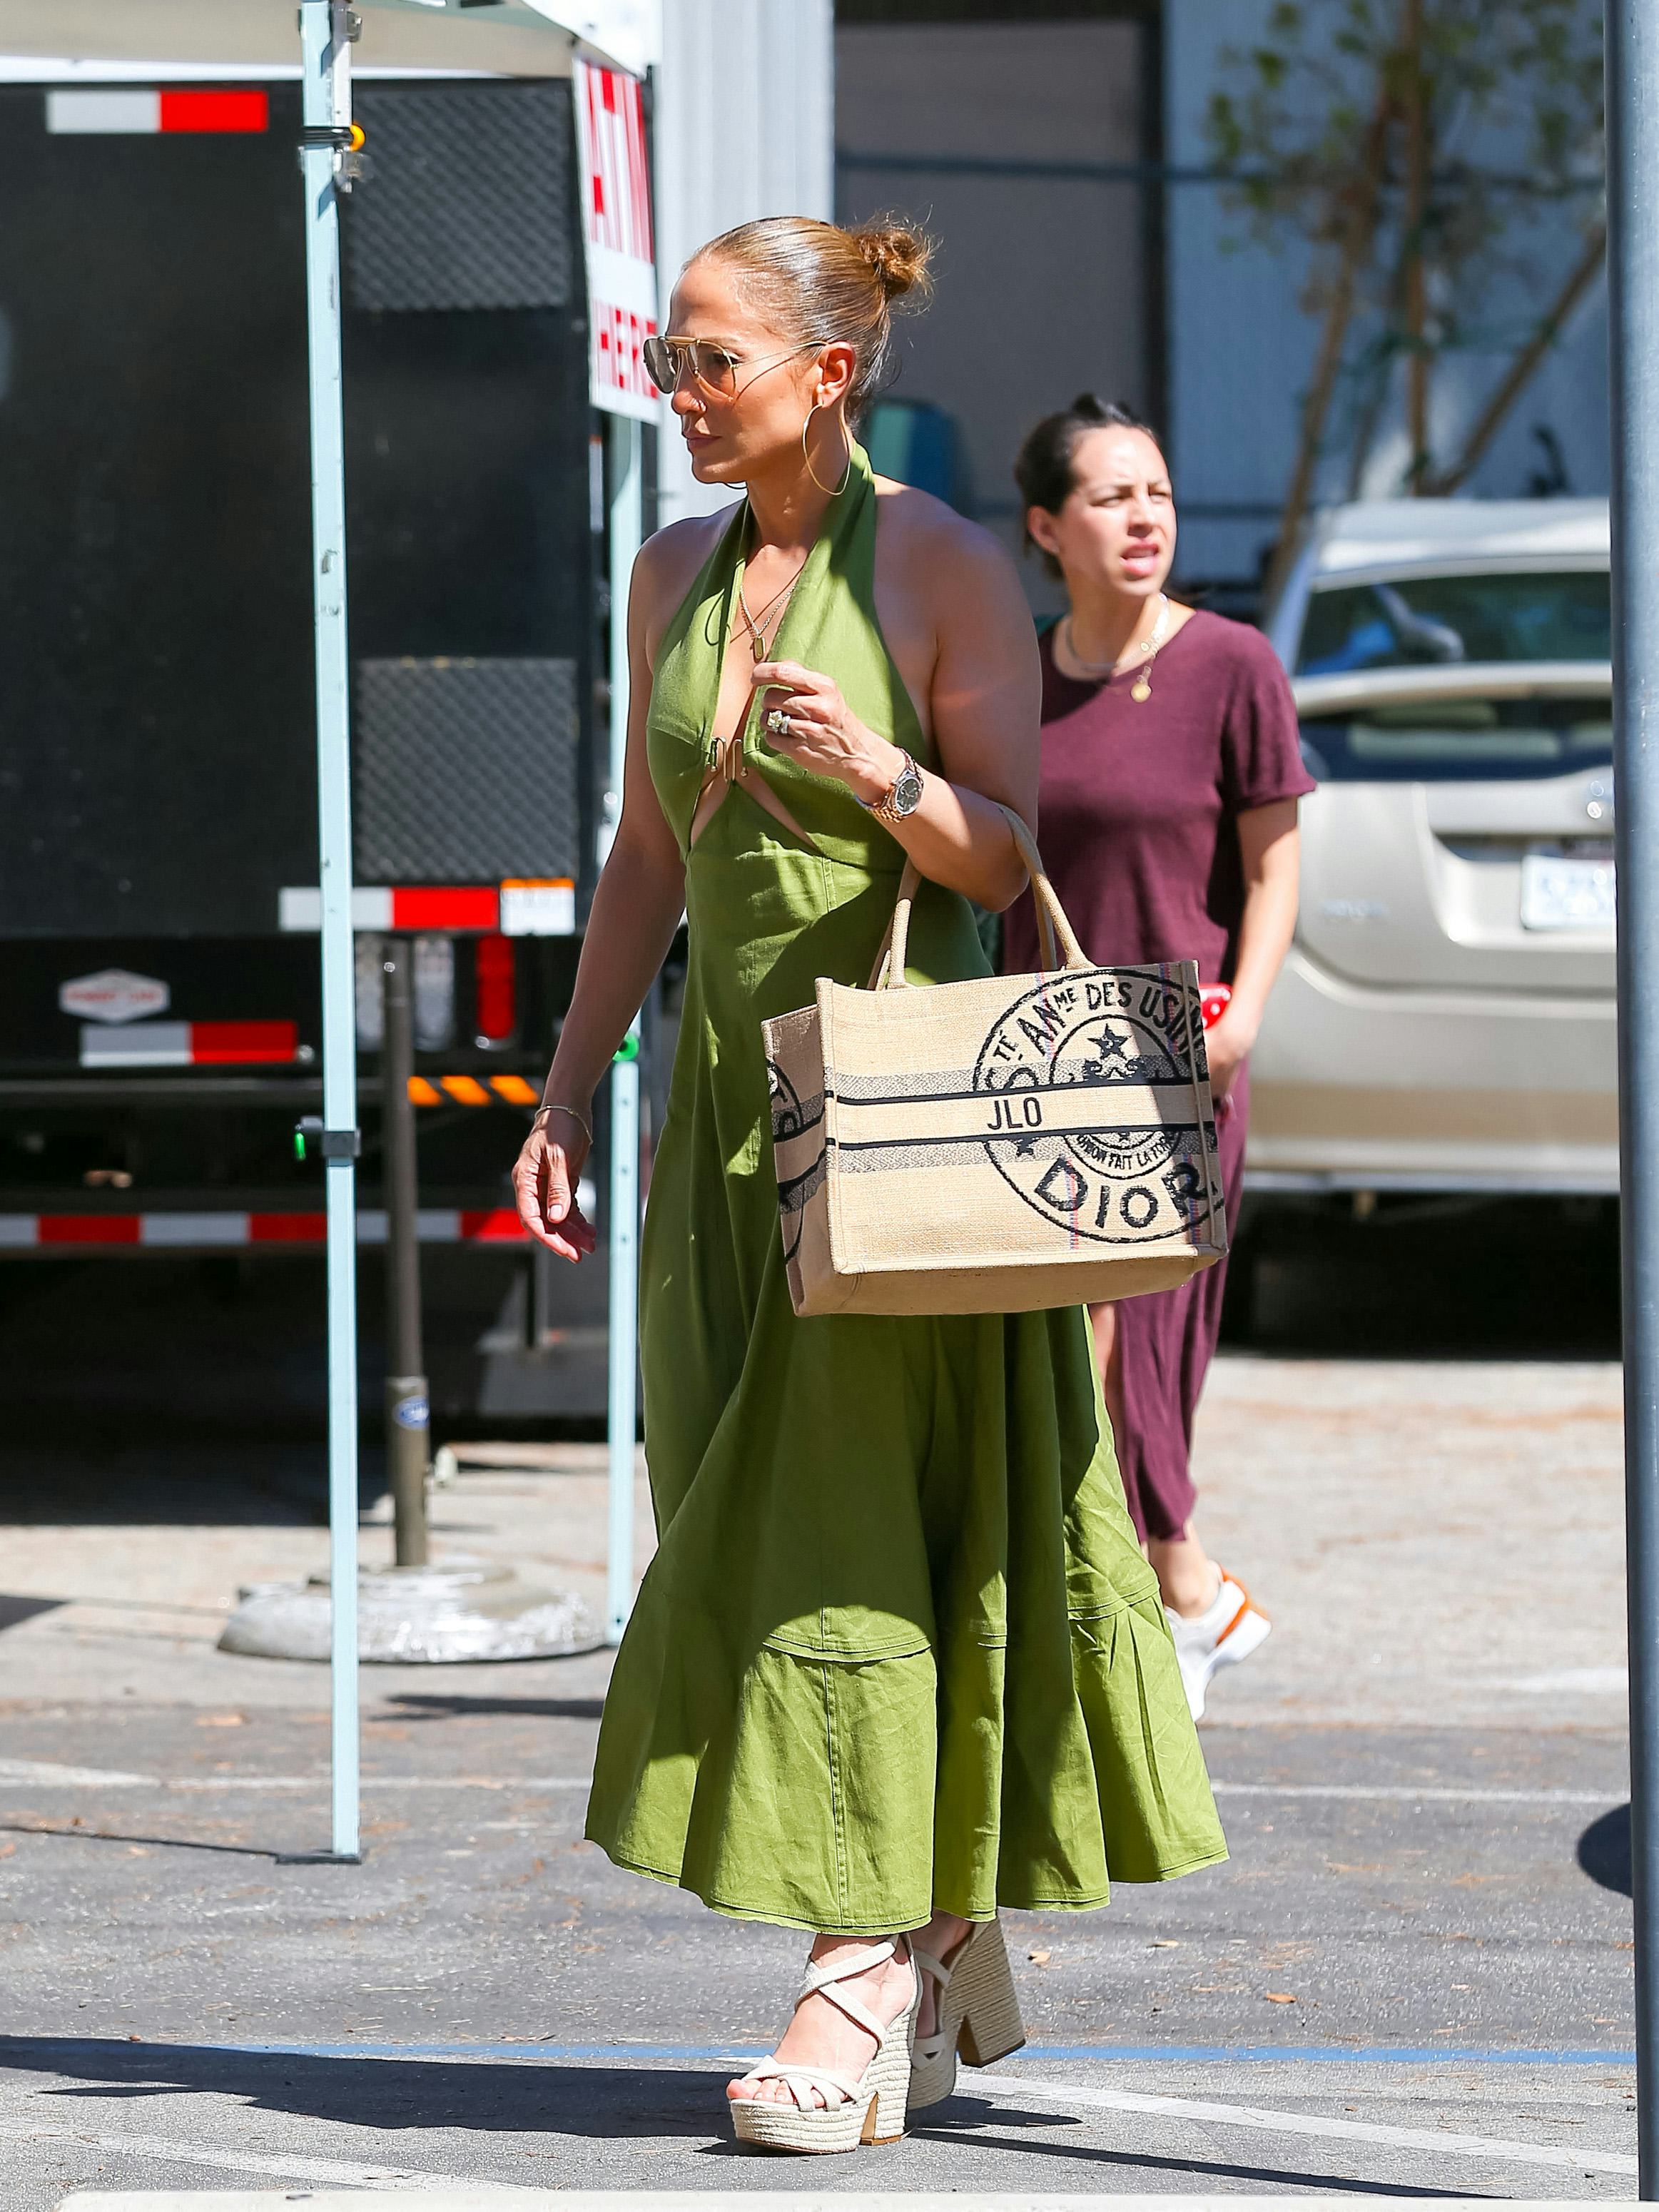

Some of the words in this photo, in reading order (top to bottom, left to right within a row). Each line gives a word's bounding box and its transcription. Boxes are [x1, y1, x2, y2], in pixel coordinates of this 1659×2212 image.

[1085, 982, 1132, 1010] DES
[987, 1096, 1042, 1130] JLO
[1035, 1155, 1217, 1228] DIOR
